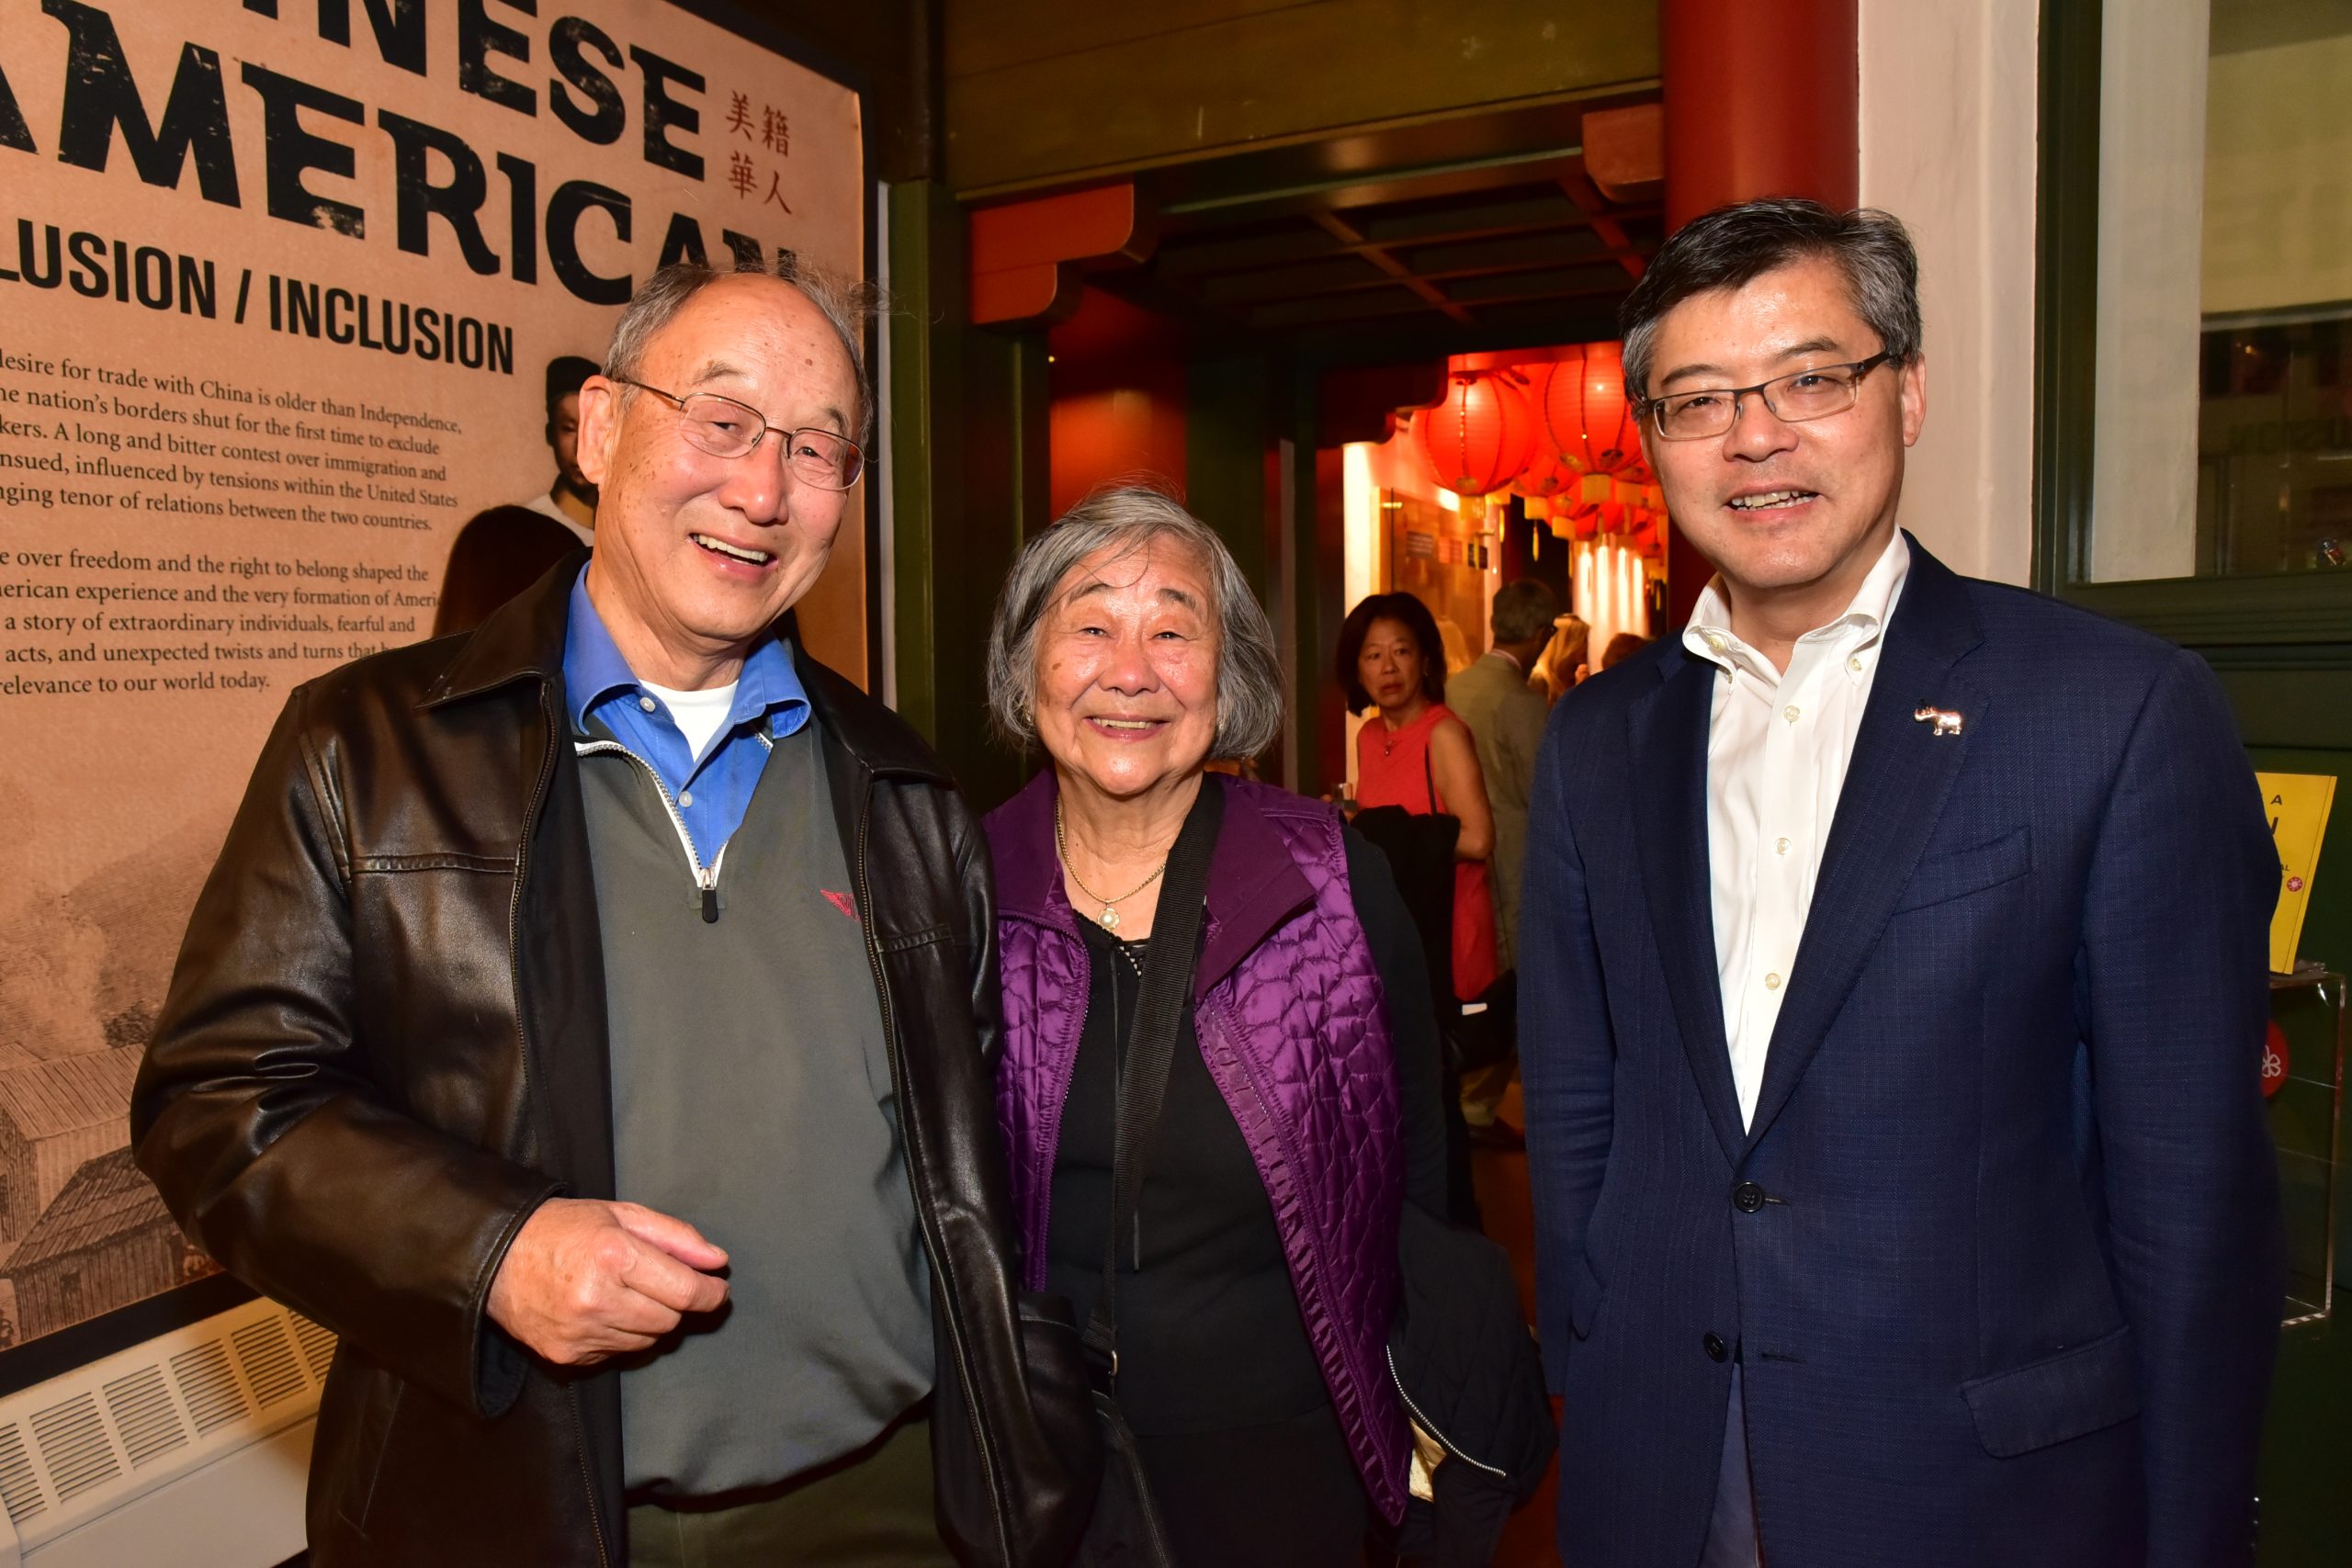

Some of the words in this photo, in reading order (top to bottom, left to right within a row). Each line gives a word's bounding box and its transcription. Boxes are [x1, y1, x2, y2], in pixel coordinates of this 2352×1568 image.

[0, 219, 217, 320] USION
[269, 275, 514, 376] INCLUSION
[61, 358, 92, 381] for
[97, 367, 148, 389] trade
[153, 375, 195, 396] with
[199, 380, 253, 403] China
[258, 388, 271, 406] is
[275, 391, 317, 412] older
[322, 398, 356, 418] than
[359, 403, 462, 434] Independence,
[26, 389, 108, 414] nation’s
[113, 396, 187, 424] borders
[192, 408, 231, 430] shut
[235, 412, 261, 433] for
[265, 417, 291, 436] the
[295, 421, 326, 441] first
[330, 426, 365, 446] time
[368, 434, 384, 448] to
[387, 435, 440, 456] exclude
[53, 422, 70, 441] A
[75, 423, 121, 453] long
[126, 432, 163, 451] and
[167, 433, 217, 457] bitter
[221, 446, 281, 464] contest
[286, 453, 321, 468] over
[324, 452, 417, 479] immigration
[421, 466, 447, 481] and
[75, 455, 177, 482] influenced
[182, 465, 205, 491] by
[209, 470, 279, 491] tensions
[283, 477, 335, 497] within
[339, 480, 363, 499] the
[367, 484, 415, 503] United
[419, 490, 458, 508] States
[59, 488, 114, 507] tenor
[119, 491, 141, 510] of
[145, 492, 224, 516] relations
[228, 498, 297, 521] between
[301, 504, 326, 524] the
[330, 510, 359, 525] two
[362, 513, 433, 531] countries.
[17, 552, 63, 568] over
[69, 547, 152, 570] freedom
[156, 554, 191, 572] and
[197, 554, 225, 574] the
[230, 557, 270, 580] right
[275, 561, 292, 576] to
[295, 558, 349, 583] belong
[352, 562, 403, 584] shaped
[406, 565, 429, 581] the
[0, 579, 70, 599] erican
[75, 582, 178, 605] experience
[184, 584, 218, 603] and
[222, 584, 250, 603] the
[254, 591, 289, 608] very
[293, 586, 370, 605] formation
[374, 589, 390, 606] of
[5, 616, 17, 630] a
[23, 614, 76, 637] story
[82, 611, 105, 631] of
[108, 612, 235, 637] extraordinary
[240, 614, 334, 633] individuals,
[337, 615, 385, 632] fearful
[389, 616, 415, 632] and
[5, 647, 53, 665] acts,
[58, 642, 97, 662] and
[103, 641, 209, 666] unexpected
[214, 642, 264, 660] twists
[267, 642, 298, 660] and
[302, 645, 344, 659] turns
[97, 677, 118, 693] to
[123, 678, 158, 692] our
[162, 671, 215, 691] world
[220, 670, 270, 693] today.
